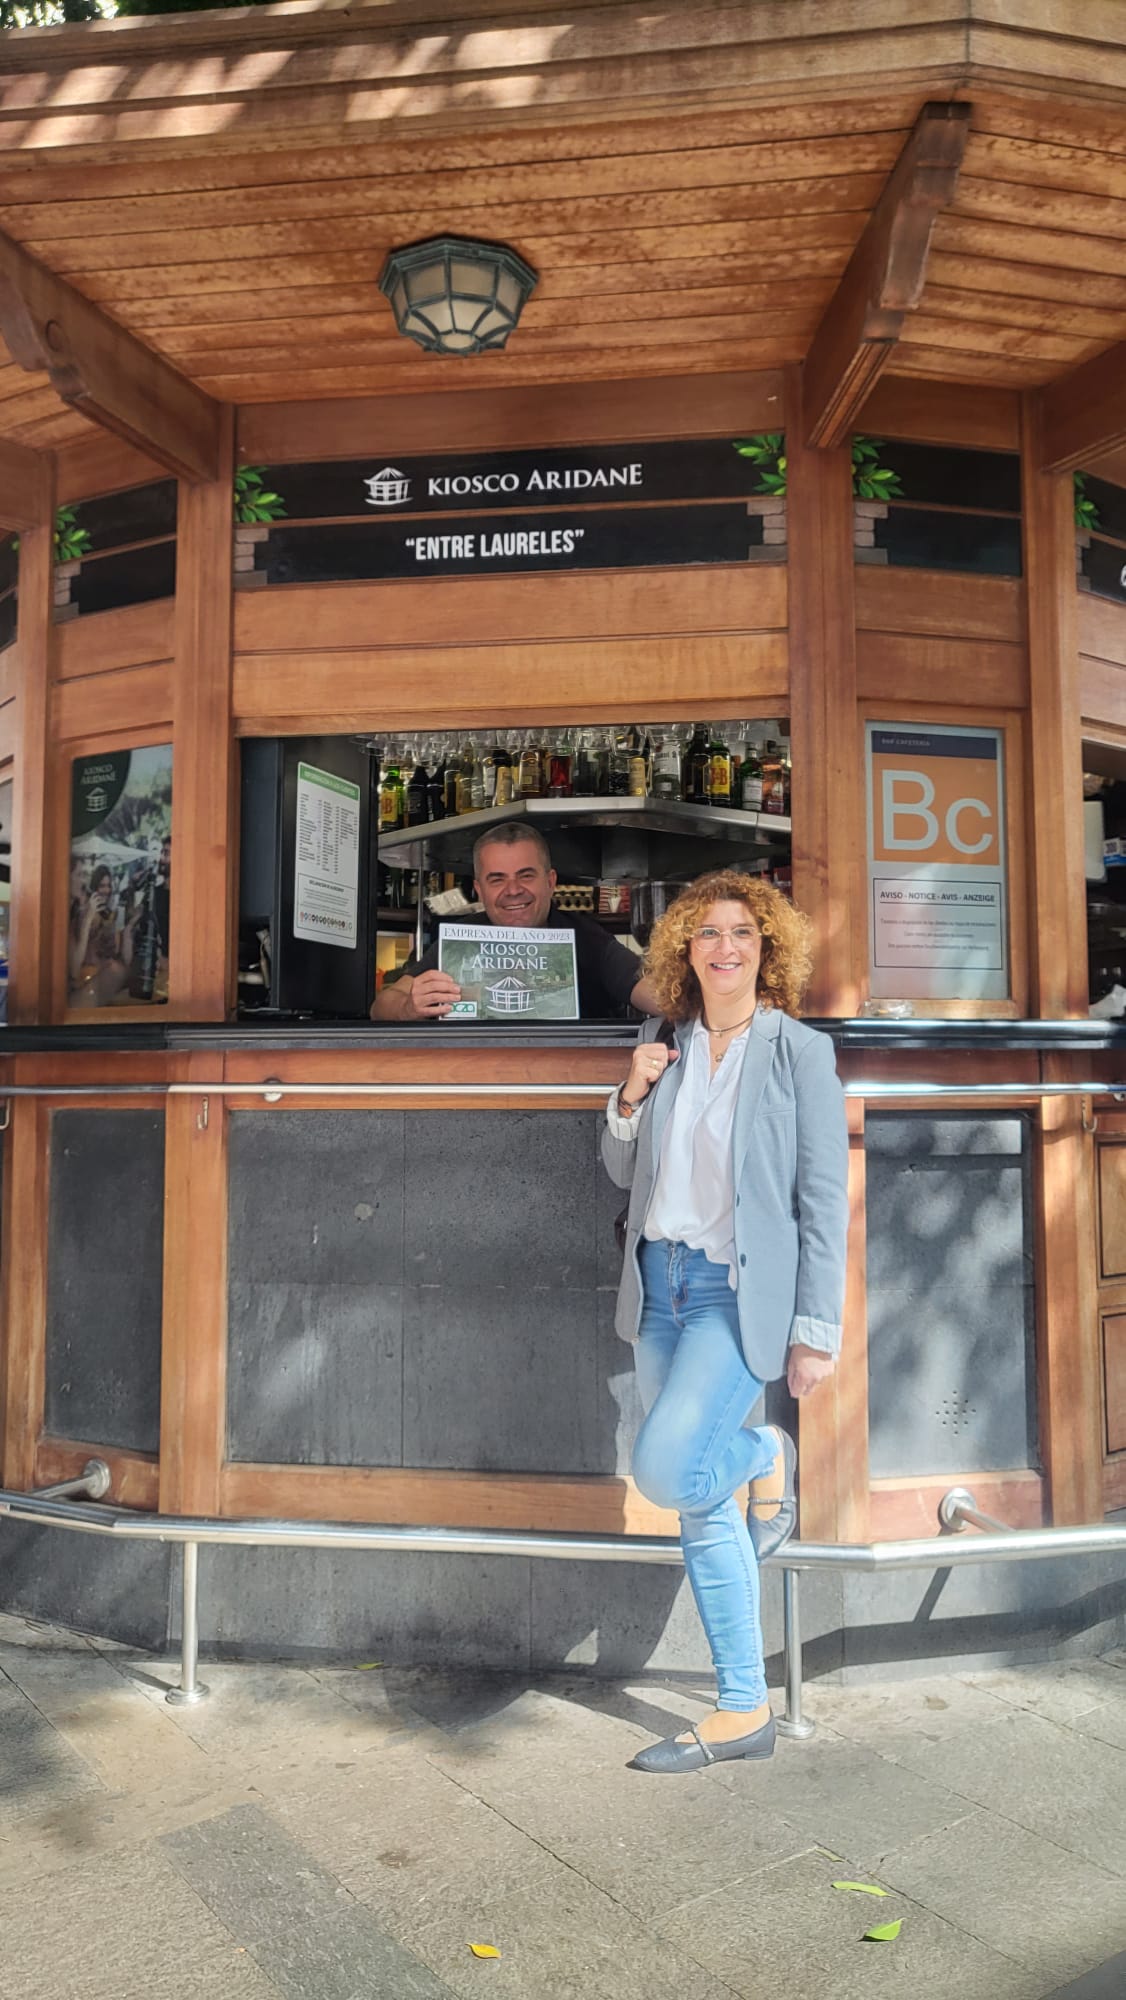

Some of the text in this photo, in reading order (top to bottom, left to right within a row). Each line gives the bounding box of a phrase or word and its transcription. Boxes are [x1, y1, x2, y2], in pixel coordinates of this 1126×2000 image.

[427, 463, 643, 496] KIOSCO ARIDANE
[405, 528, 585, 561] “ENTRE LAURELES”
[880, 891, 995, 902] AVISO NOTICE AVIS ANZEIGE
[444, 927, 570, 941] EMPRESA DEL AÑO 2023
[479, 943, 538, 956] KIOSCO
[472, 956, 548, 970] ARIDANE
